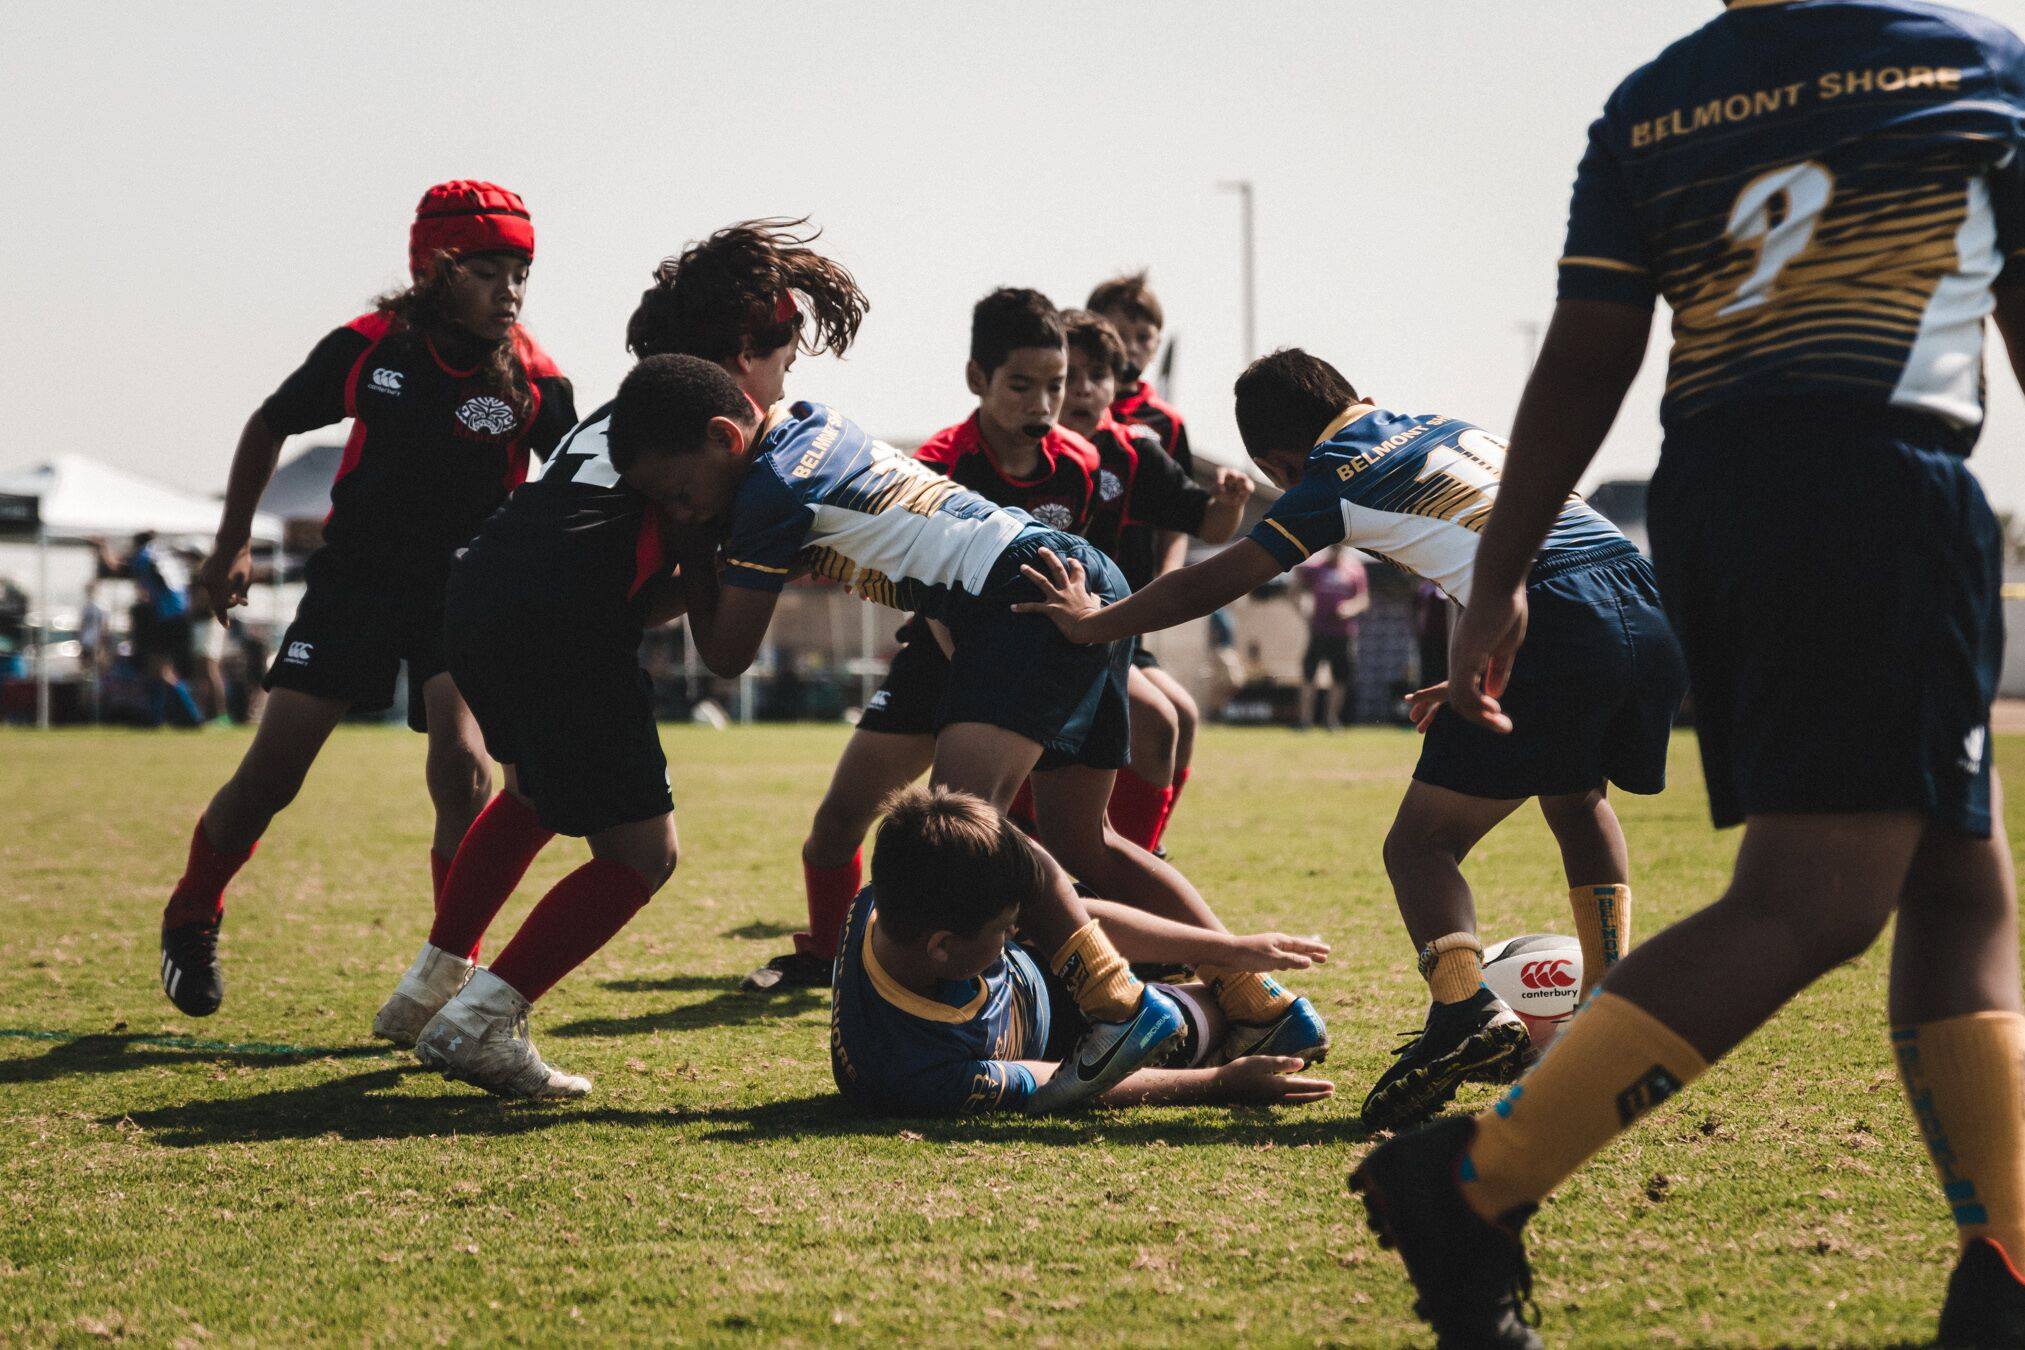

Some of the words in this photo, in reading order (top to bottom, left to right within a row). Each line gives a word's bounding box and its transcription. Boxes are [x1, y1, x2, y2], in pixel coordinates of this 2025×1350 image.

[1631, 81, 1807, 148] BELMONT
[1818, 66, 1962, 99] SHORE
[1717, 160, 1835, 318] 9
[1336, 425, 1429, 482] BELMONT
[1521, 987, 1579, 999] canterbury
[1139, 1013, 1171, 1050] ERCURIAL
